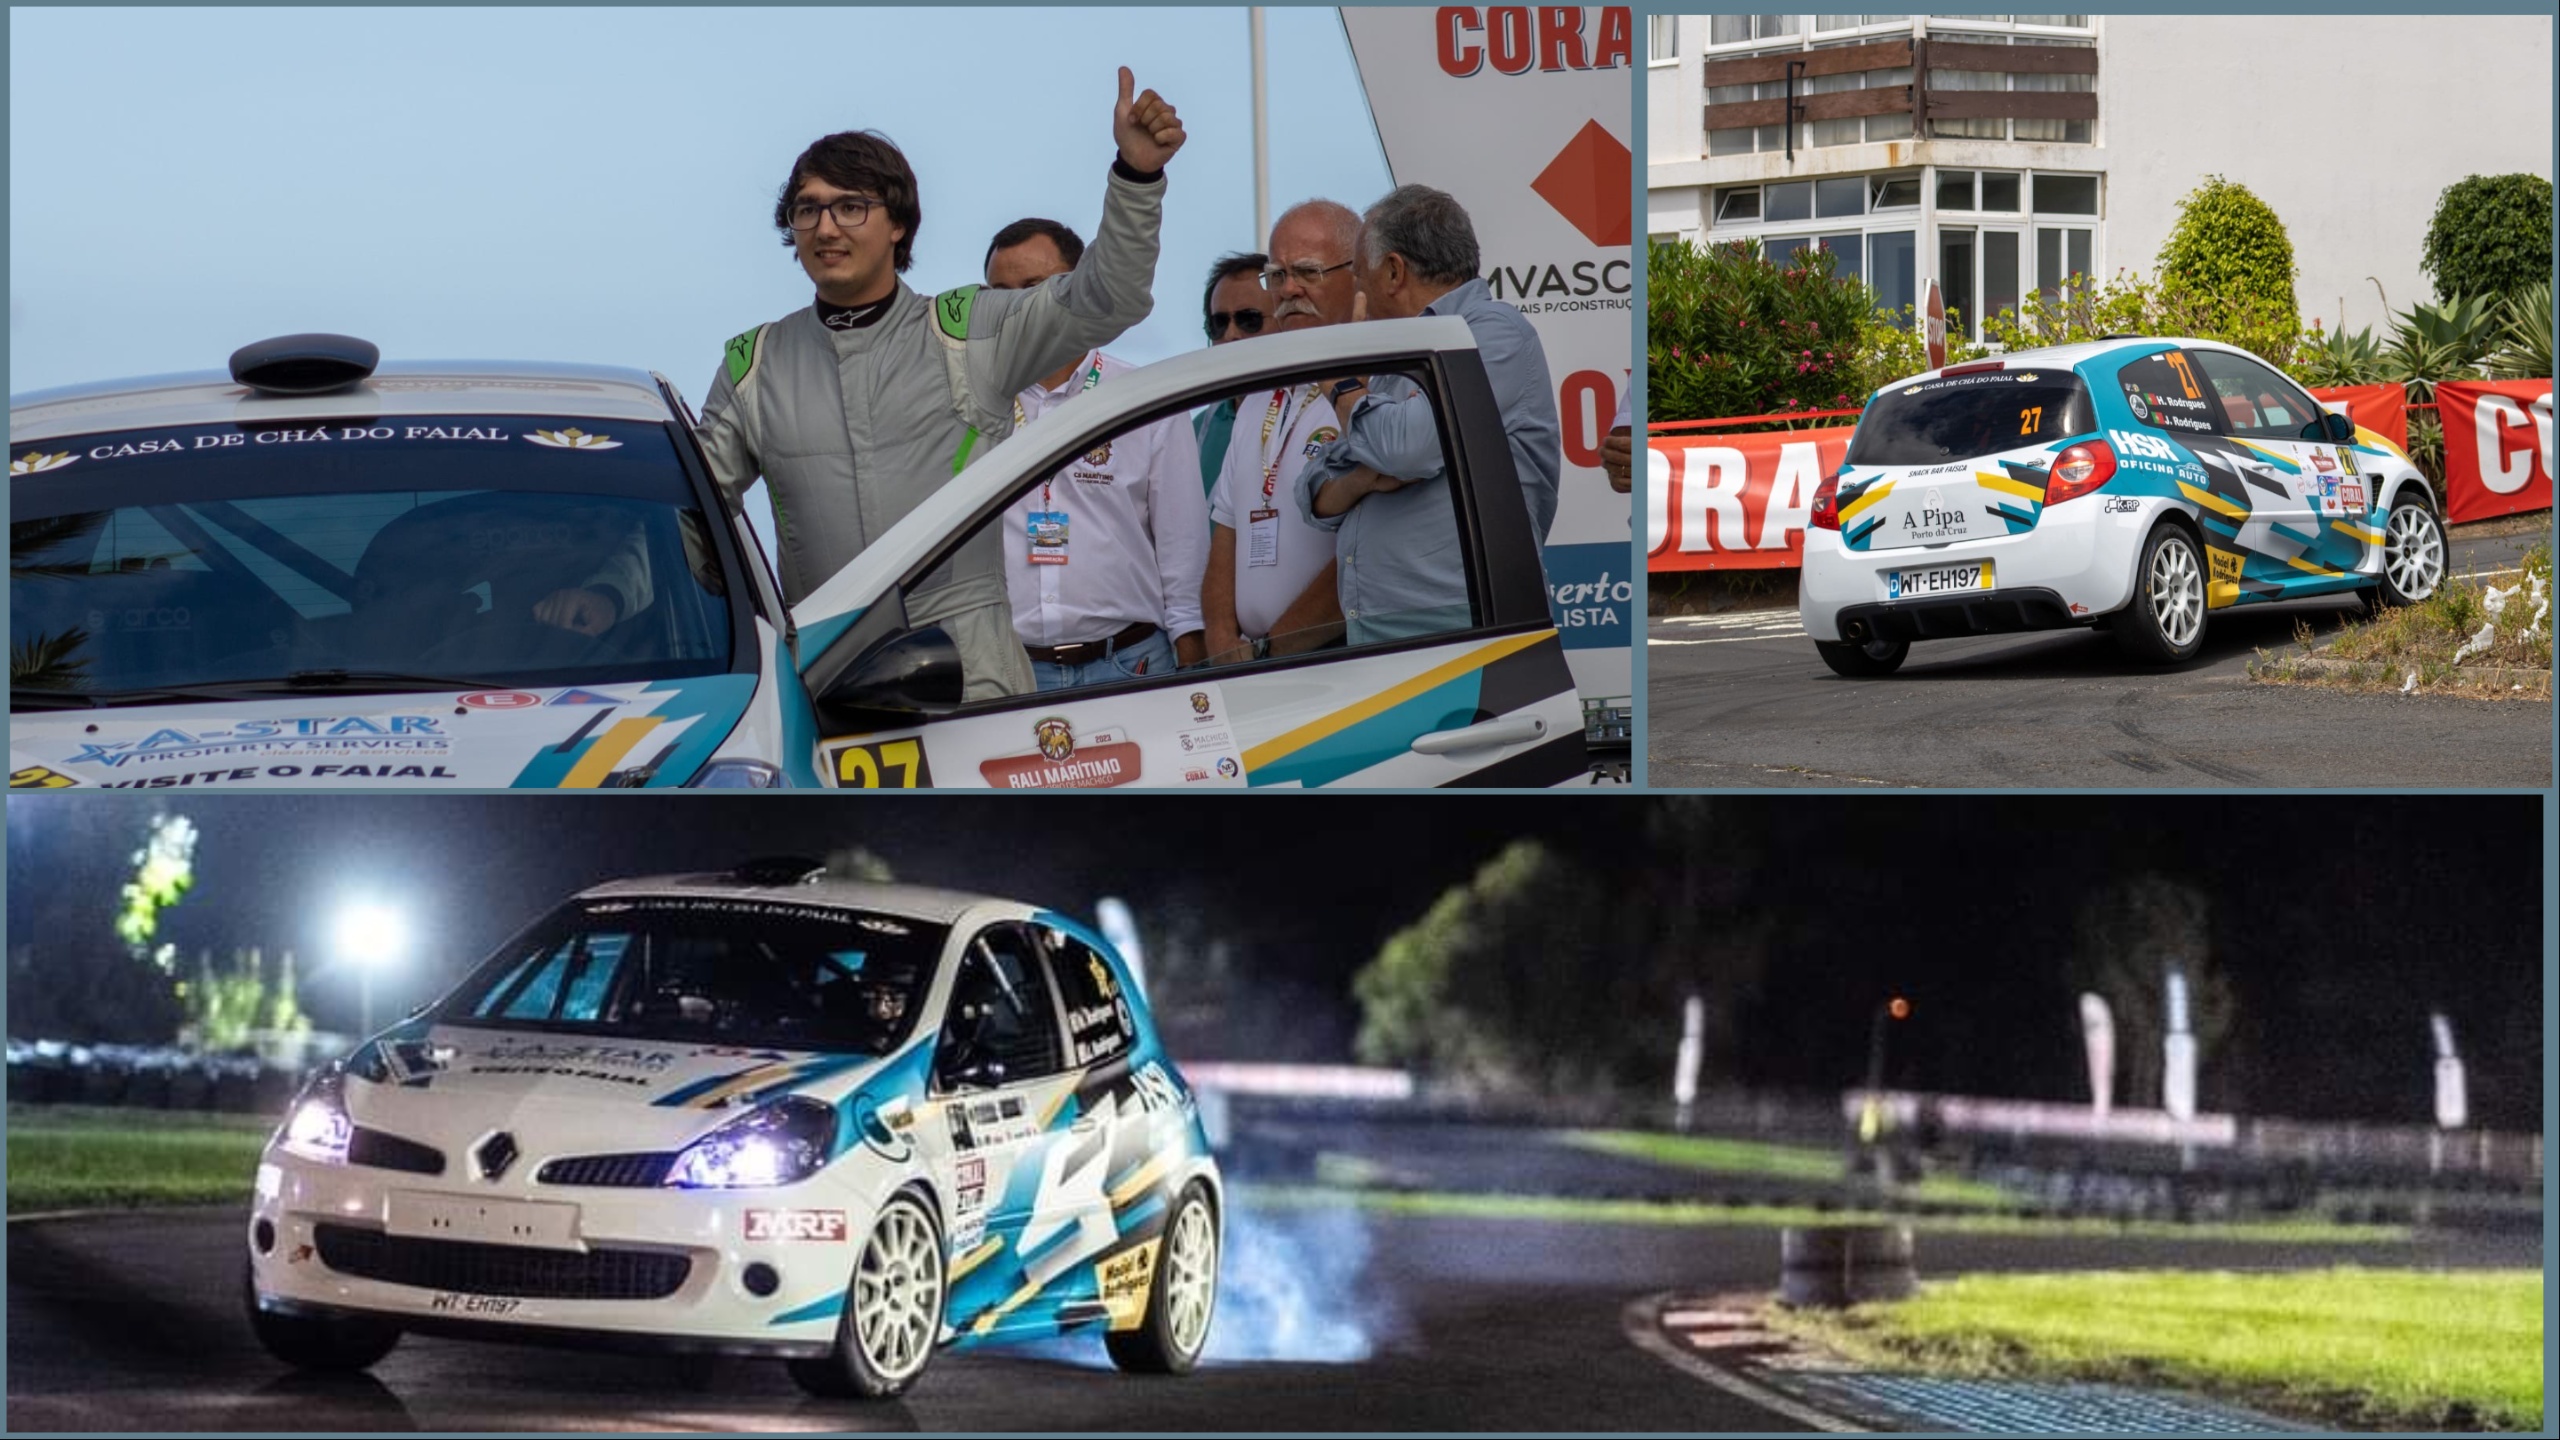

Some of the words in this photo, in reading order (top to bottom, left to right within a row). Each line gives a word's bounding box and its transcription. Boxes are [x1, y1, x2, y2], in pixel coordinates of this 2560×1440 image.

[1436, 6, 1632, 77] CORA
[1928, 315, 1944, 346] STOP
[1924, 382, 1944, 390] CASA
[1958, 376, 1975, 386] CHÁ
[2164, 351, 2203, 399] 27
[2156, 395, 2167, 406] H.
[2167, 397, 2206, 410] Rodrigues
[1560, 369, 1632, 468] O
[2020, 406, 2042, 435] 27
[2165, 415, 2173, 425] J.
[2173, 416, 2212, 430] Rodrigues
[90, 438, 185, 460] CASA
[194, 433, 244, 449] DE
[255, 426, 333, 444] CHÁ
[341, 427, 395, 441] DO
[404, 426, 509, 441] FAIAL
[2108, 429, 2180, 462] HSR
[1907, 468, 1930, 478] SNACK
[1930, 467, 1944, 475] BAR
[1944, 464, 1968, 473] FAÍSCA
[2119, 459, 2174, 475] OFICINA
[2179, 469, 2206, 485] AUTO
[2336, 447, 2358, 476] 27
[2341, 486, 2364, 503] CORAL
[1902, 511, 1917, 530] A
[1922, 508, 1965, 530] Pipa
[1911, 530, 1934, 540] Porto
[1935, 528, 1946, 537] da
[1947, 527, 1968, 536] Cruz
[1549, 571, 1632, 604] erto
[1890, 578, 1898, 592] D
[137, 715, 446, 751] A-STAR
[1094, 733, 1112, 744] 2023
[1194, 732, 1229, 744] MACHICO
[139, 741, 297, 764] PROPERTY
[306, 739, 449, 749] SERVICES
[267, 764, 303, 778] O
[310, 764, 457, 778] FAIAL
[1008, 770, 1044, 788] RALI
[1043, 757, 1122, 785] MARÍTIMO
[1077, 774, 1114, 787] MACHICO
[1185, 770, 1210, 782] CORAL
[747, 1211, 844, 1237] MRF
